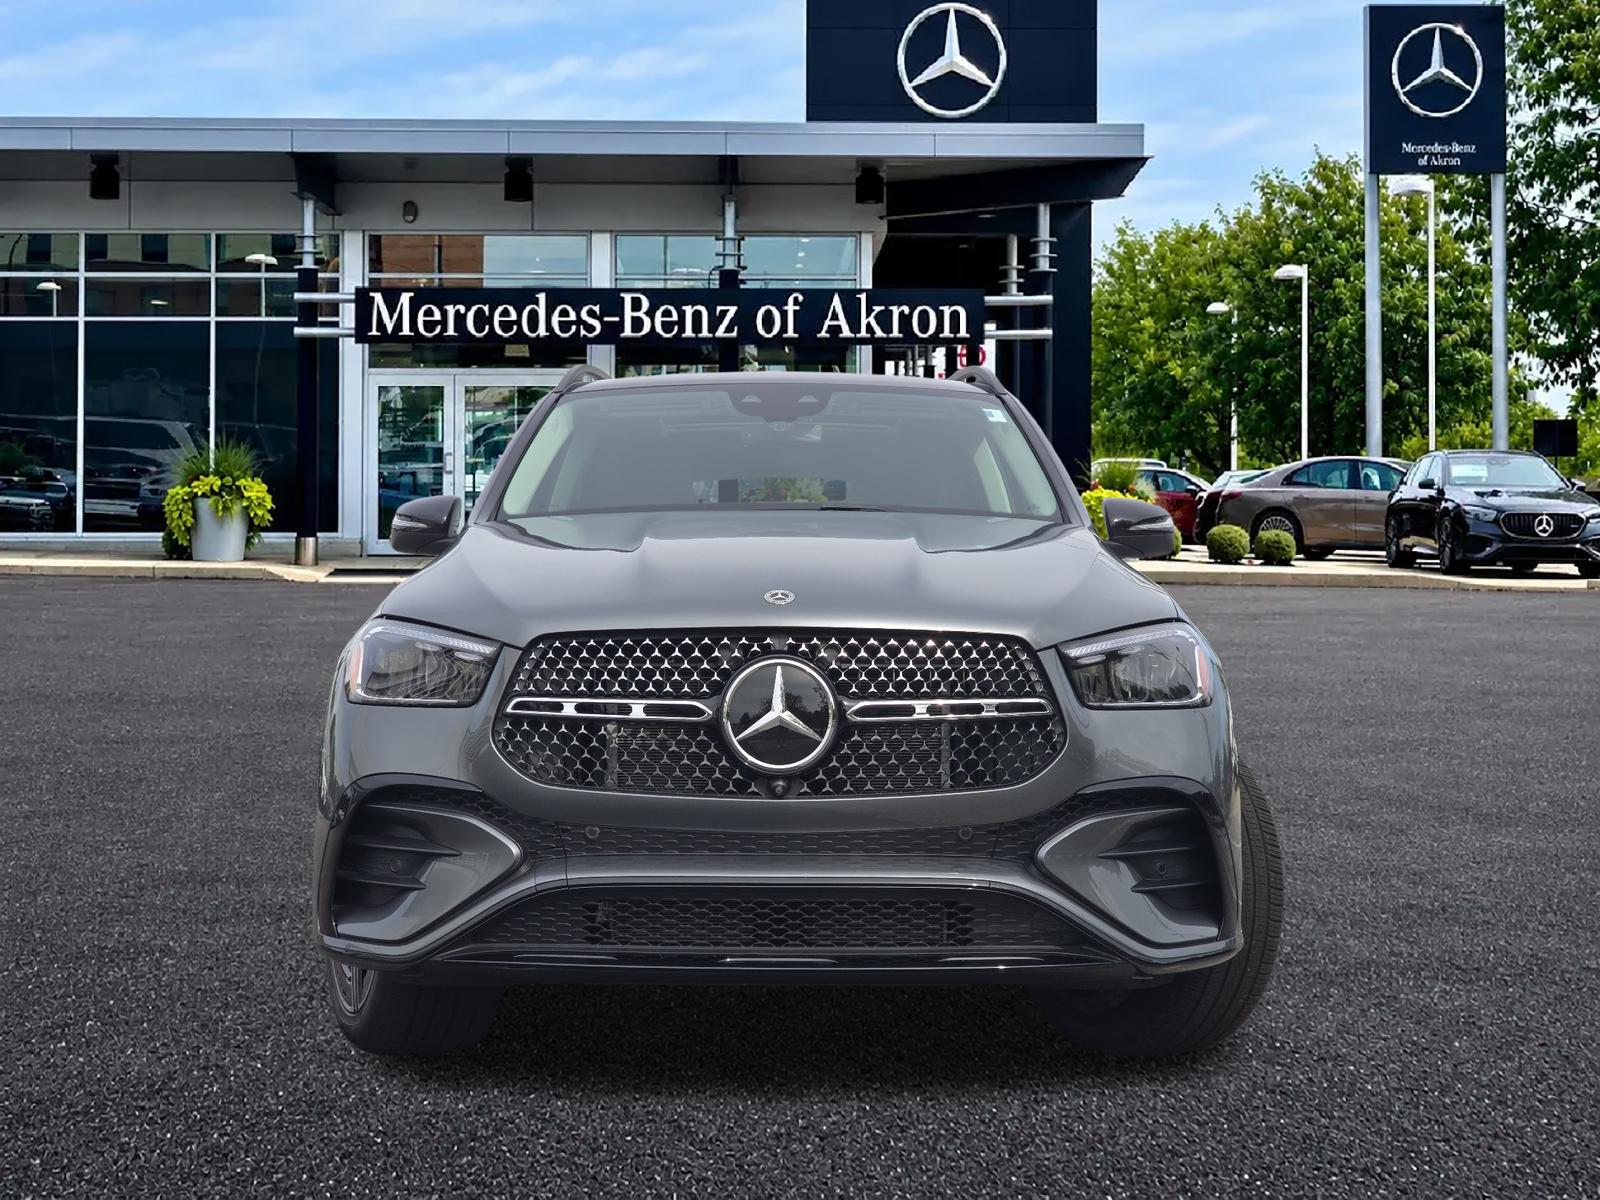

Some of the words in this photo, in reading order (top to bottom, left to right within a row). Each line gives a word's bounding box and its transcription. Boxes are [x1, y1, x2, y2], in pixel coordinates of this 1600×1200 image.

[1401, 141, 1477, 154] Mercedes-Benz
[1417, 154, 1429, 166] of
[1430, 154, 1461, 166] Akron
[367, 292, 739, 339] Mercedes-Benz
[755, 291, 804, 339] of
[816, 292, 971, 339] Akron
